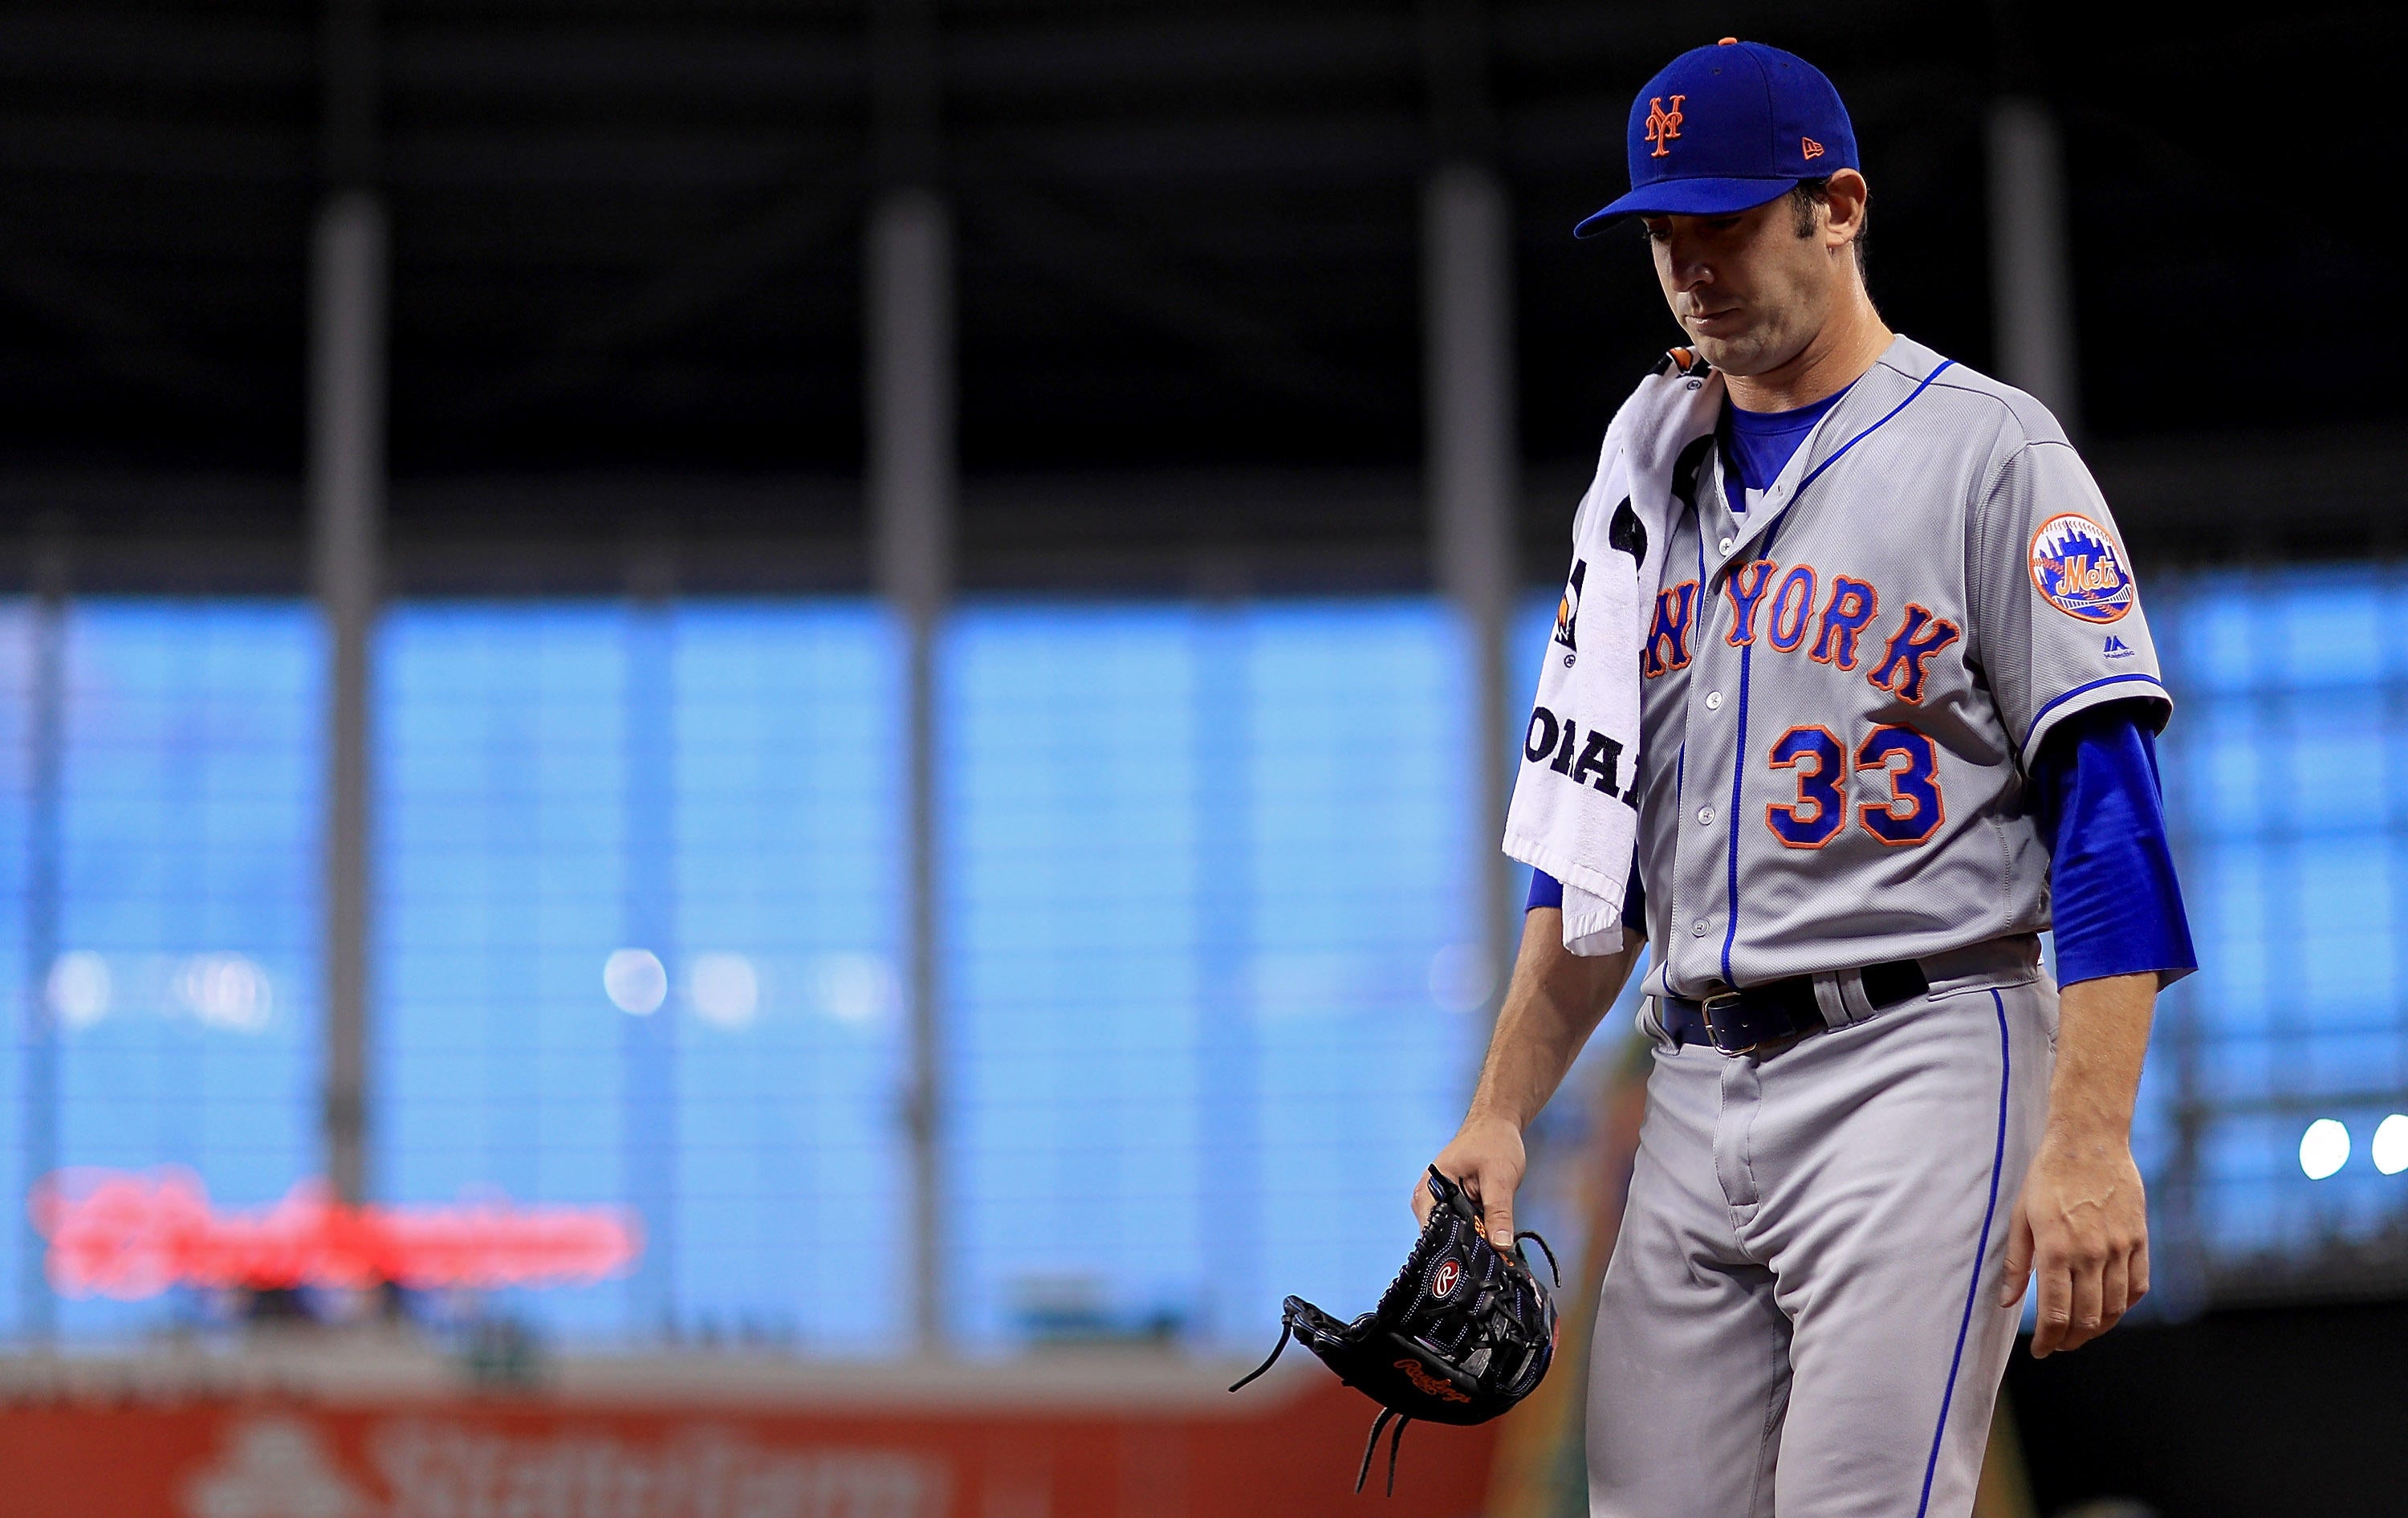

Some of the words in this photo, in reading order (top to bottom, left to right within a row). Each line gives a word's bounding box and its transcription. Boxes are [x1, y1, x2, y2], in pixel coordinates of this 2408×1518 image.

[2056, 554, 2121, 596] Mets
[1724, 560, 1960, 706] YORK
[1765, 723, 1946, 850] 33
[1393, 1358, 1471, 1403] Rawlings
